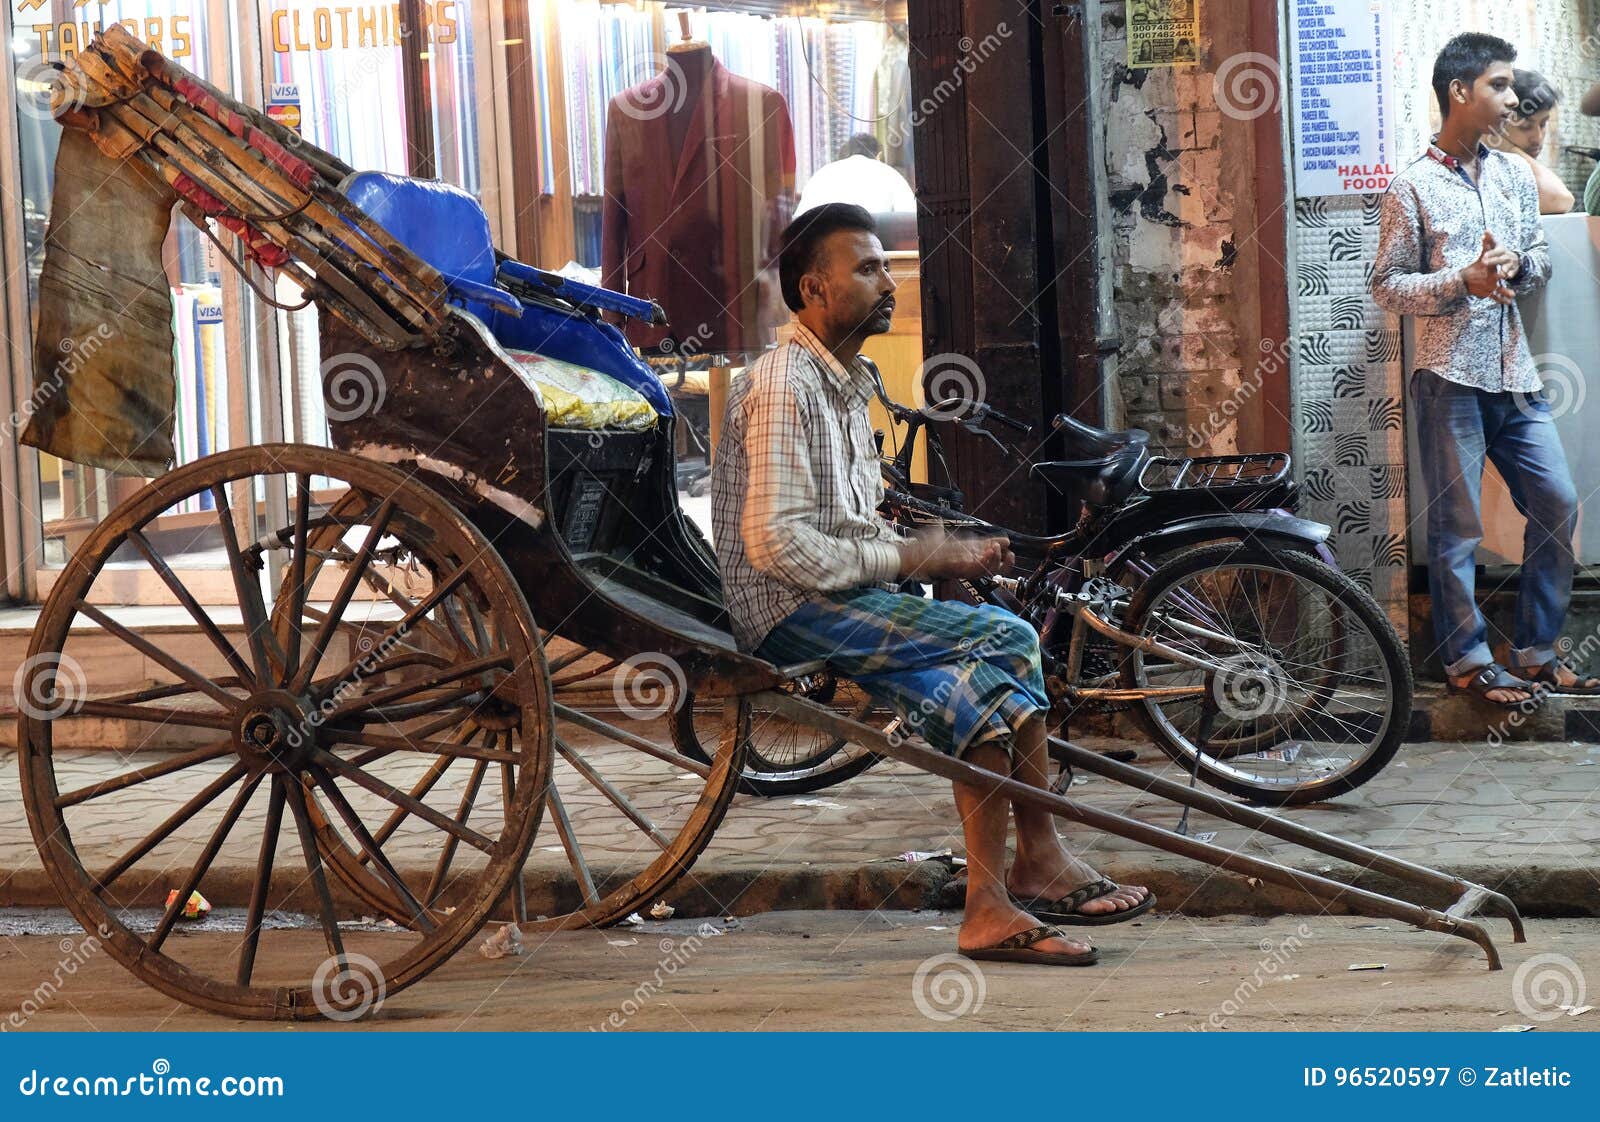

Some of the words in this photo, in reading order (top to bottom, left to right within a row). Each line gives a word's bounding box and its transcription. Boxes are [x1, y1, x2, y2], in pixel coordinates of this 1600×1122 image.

[1132, 31, 1194, 39] 9007482446
[274, 87, 299, 96] VISA
[1338, 164, 1394, 176] HALAL
[1343, 177, 1389, 190] FOOD
[200, 307, 222, 317] VISA
